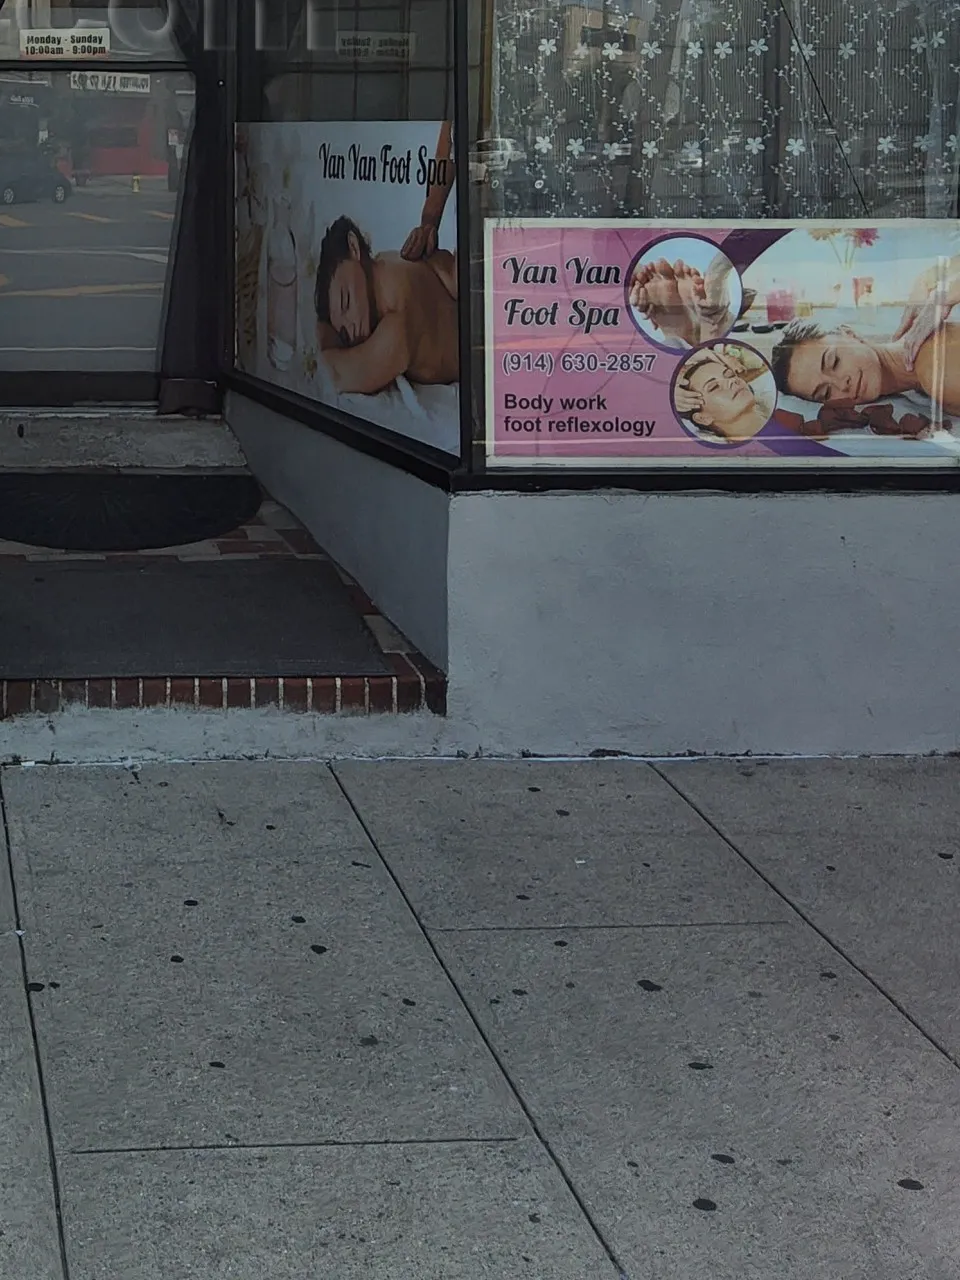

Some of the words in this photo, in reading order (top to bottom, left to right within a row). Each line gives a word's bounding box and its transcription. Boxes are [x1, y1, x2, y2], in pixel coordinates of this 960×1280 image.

[25, 45, 63, 55] 10:00am
[72, 45, 106, 55] 9:00pm
[26, 34, 62, 45] Monday
[70, 34, 103, 45] Sunday
[319, 142, 345, 179] Yan
[348, 143, 376, 182] Yan
[380, 144, 411, 185] Foot
[416, 145, 447, 197] Spa
[502, 256, 558, 285] Yan
[565, 256, 621, 285] Yan
[503, 297, 559, 326] Foot
[568, 298, 620, 334] Spa
[502, 353, 555, 376] (914)
[561, 353, 656, 373] 630-2857
[504, 394, 553, 413] Body
[559, 394, 607, 411] work
[504, 416, 542, 433] foot
[547, 416, 656, 437] reflexology
